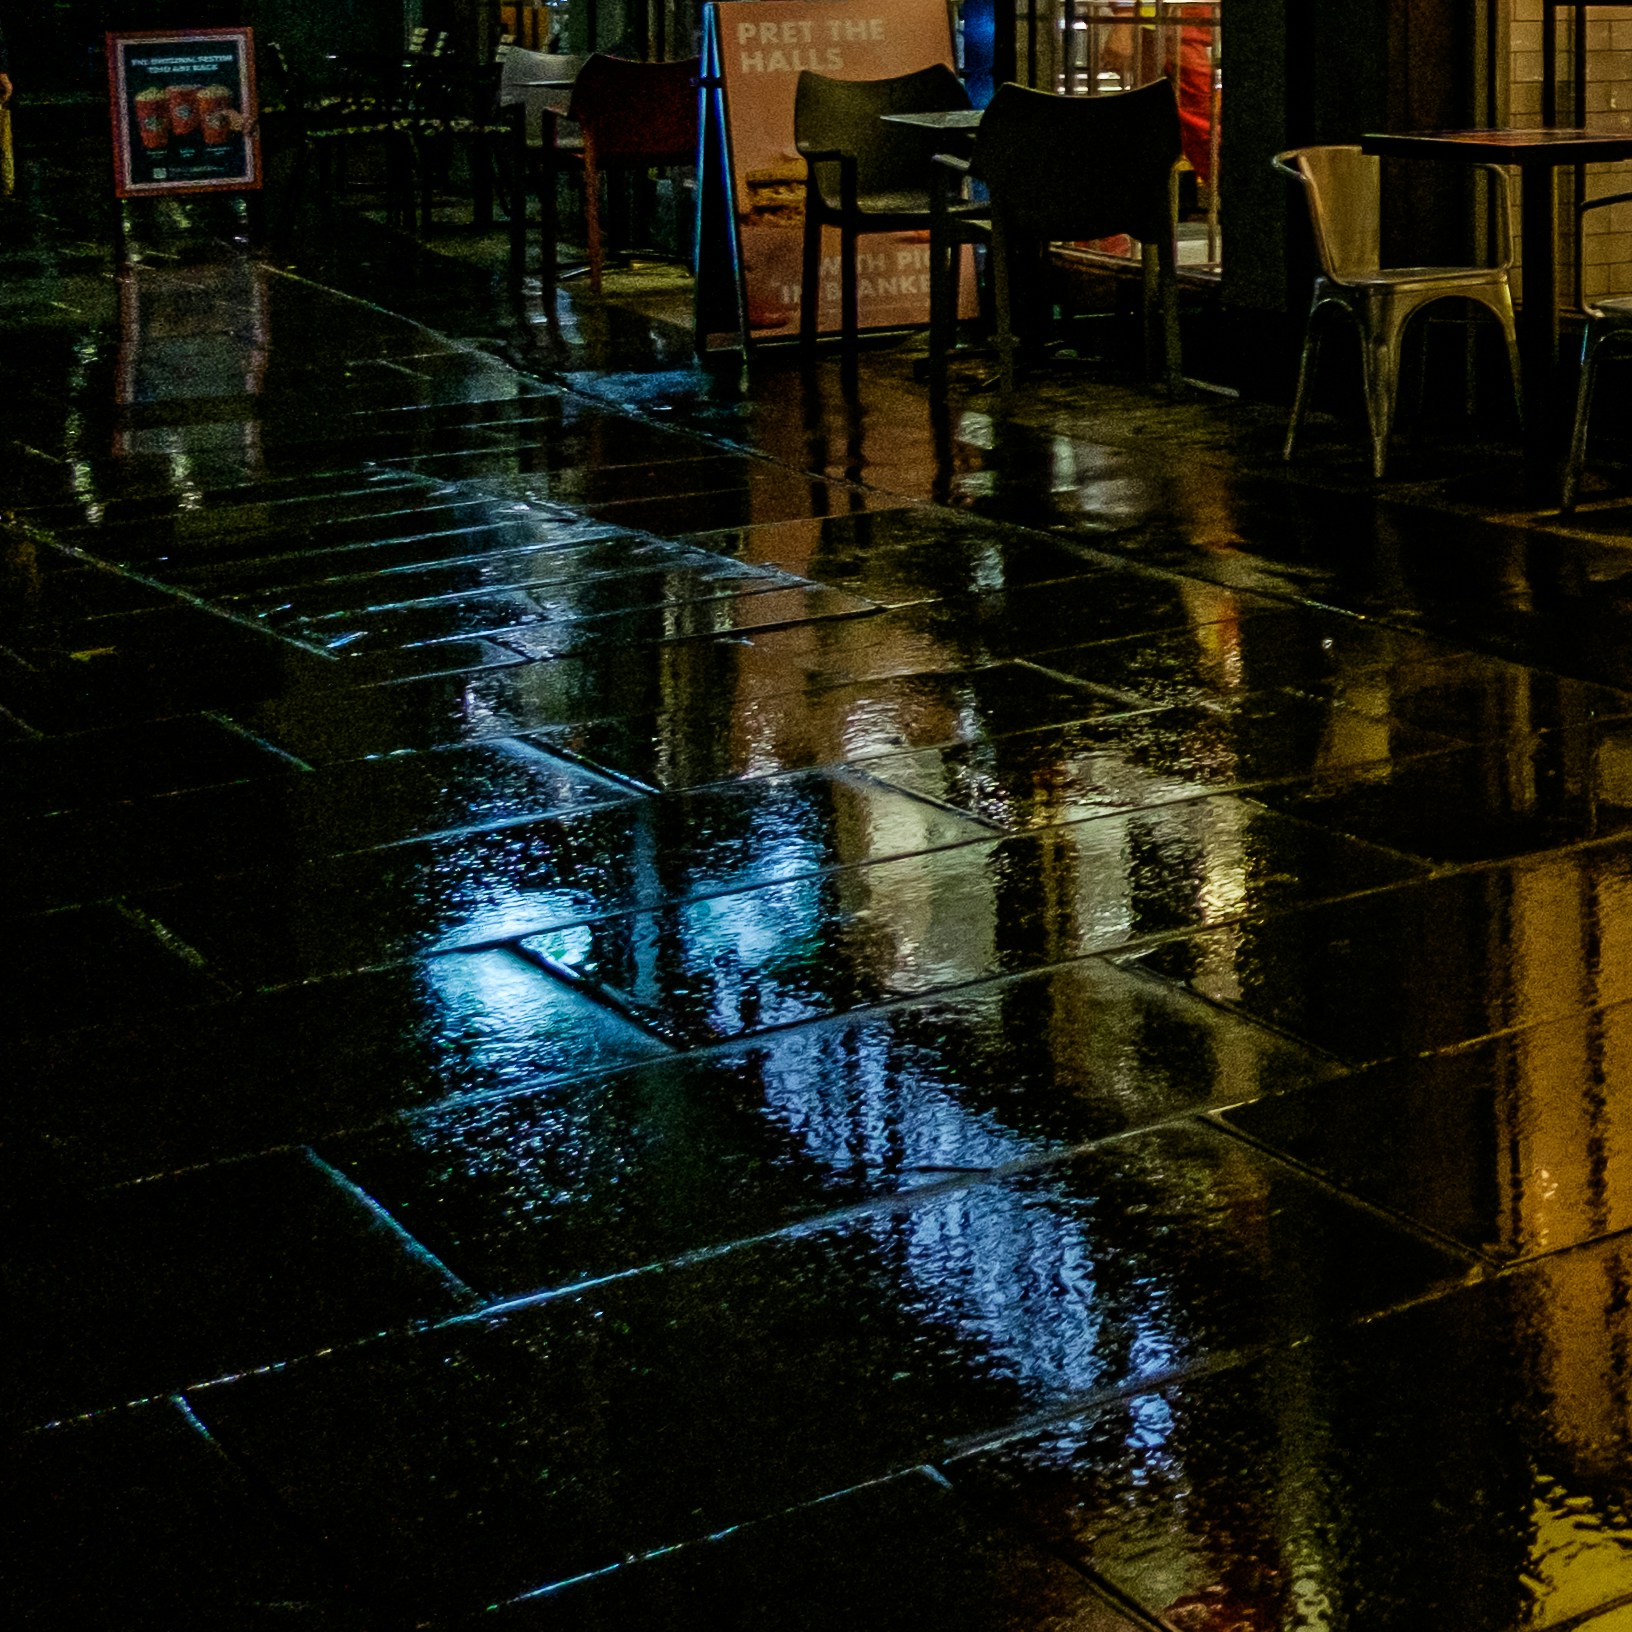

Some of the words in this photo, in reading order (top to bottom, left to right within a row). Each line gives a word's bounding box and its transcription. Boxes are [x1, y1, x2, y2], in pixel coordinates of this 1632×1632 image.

[735, 19, 813, 46] PRET
[829, 17, 886, 42] THE
[740, 47, 845, 73] HALLS
